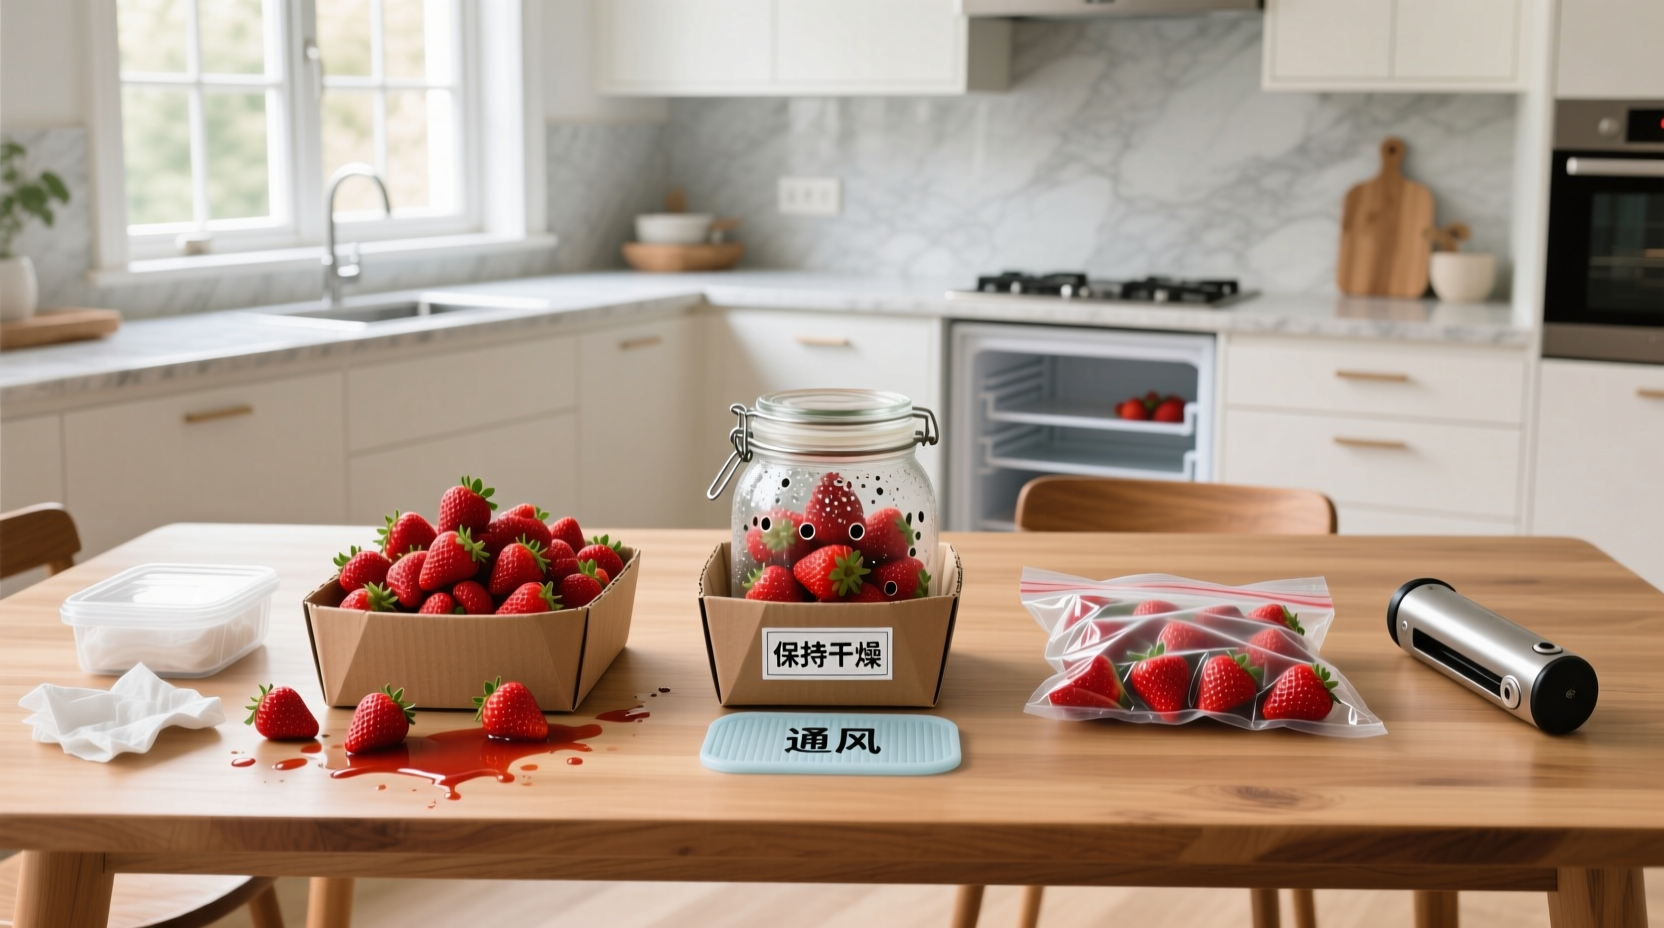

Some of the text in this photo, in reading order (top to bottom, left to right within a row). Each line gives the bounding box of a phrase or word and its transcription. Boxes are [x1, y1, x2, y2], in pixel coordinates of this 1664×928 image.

[773, 640, 882, 669] 保持干燥
[784, 727, 882, 755] 通风
